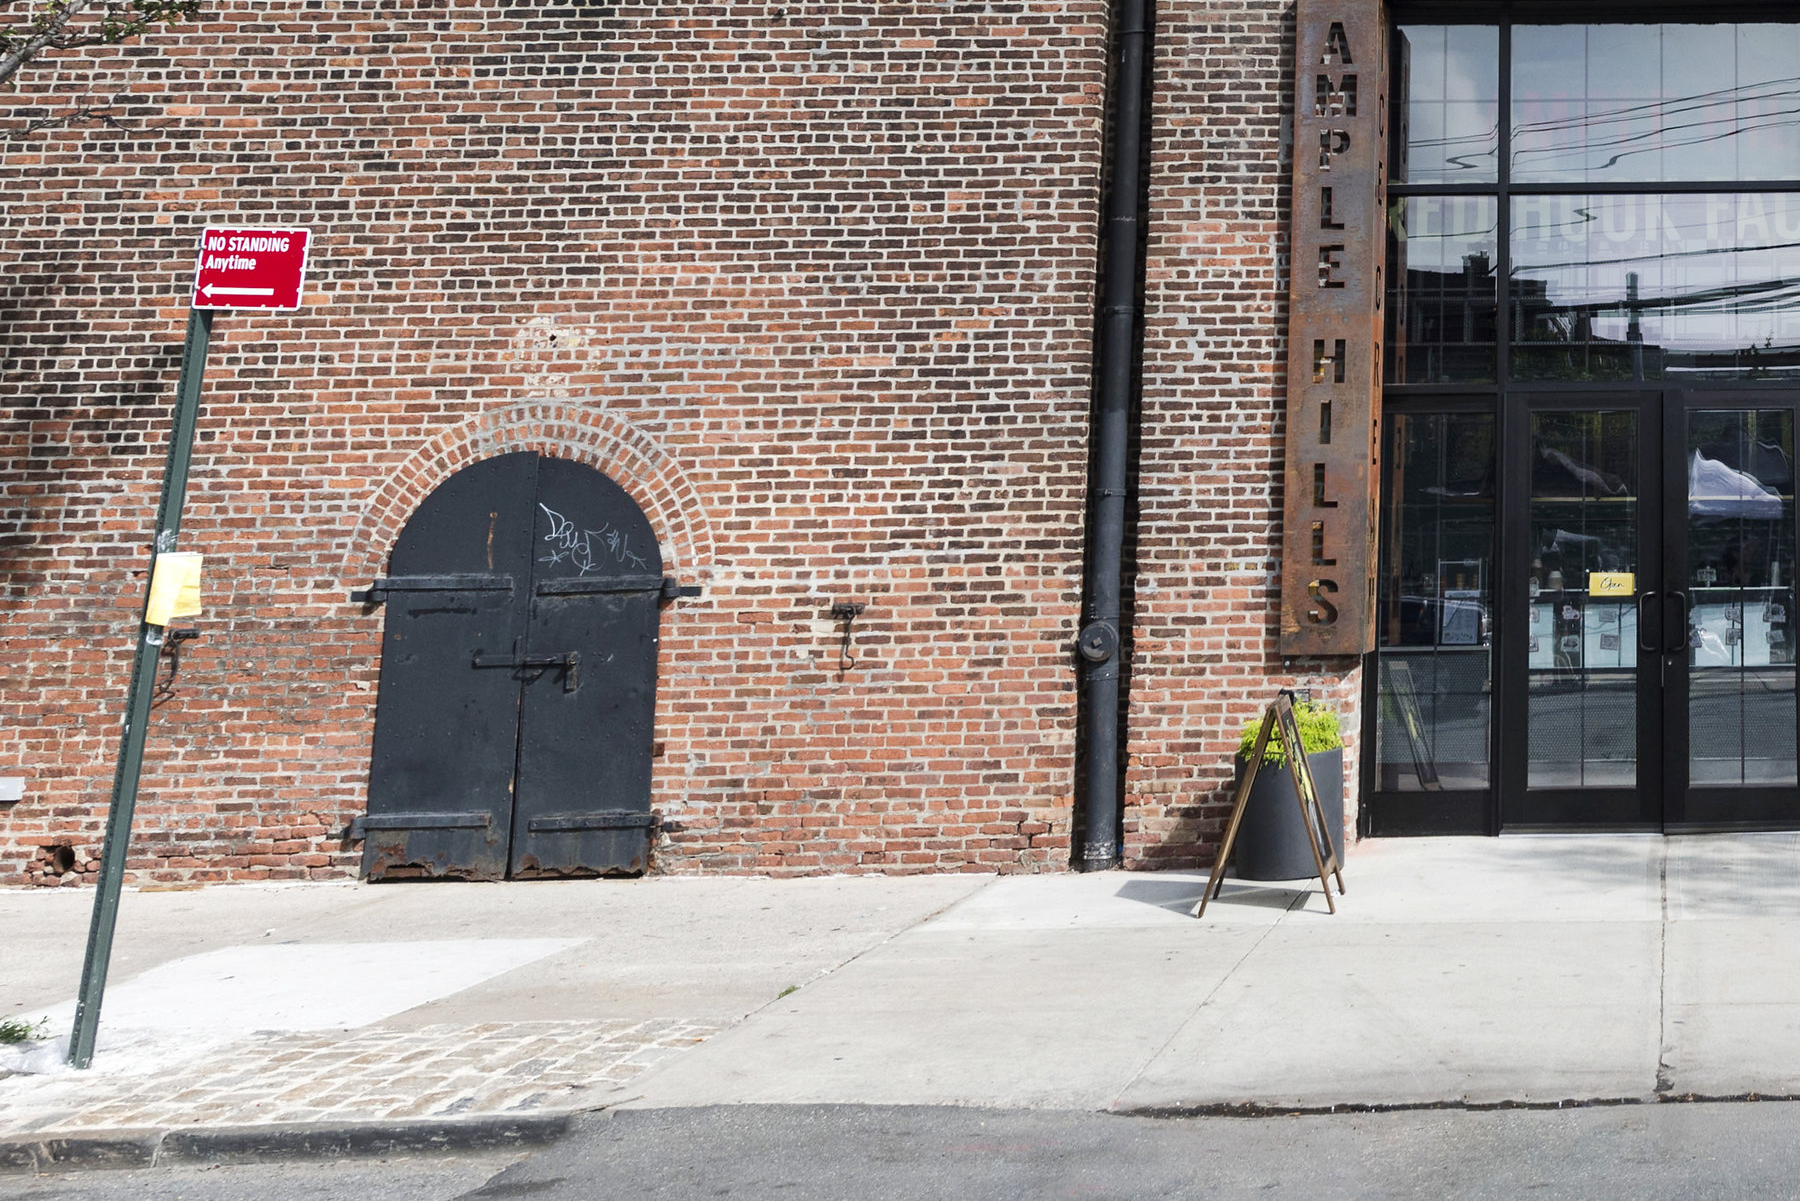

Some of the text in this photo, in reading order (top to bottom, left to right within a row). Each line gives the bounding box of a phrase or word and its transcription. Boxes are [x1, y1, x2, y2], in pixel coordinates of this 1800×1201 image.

[207, 236, 290, 252] NO STANDING
[205, 254, 257, 272] Anytime
[1306, 21, 1358, 626] AMPLE HILLS
